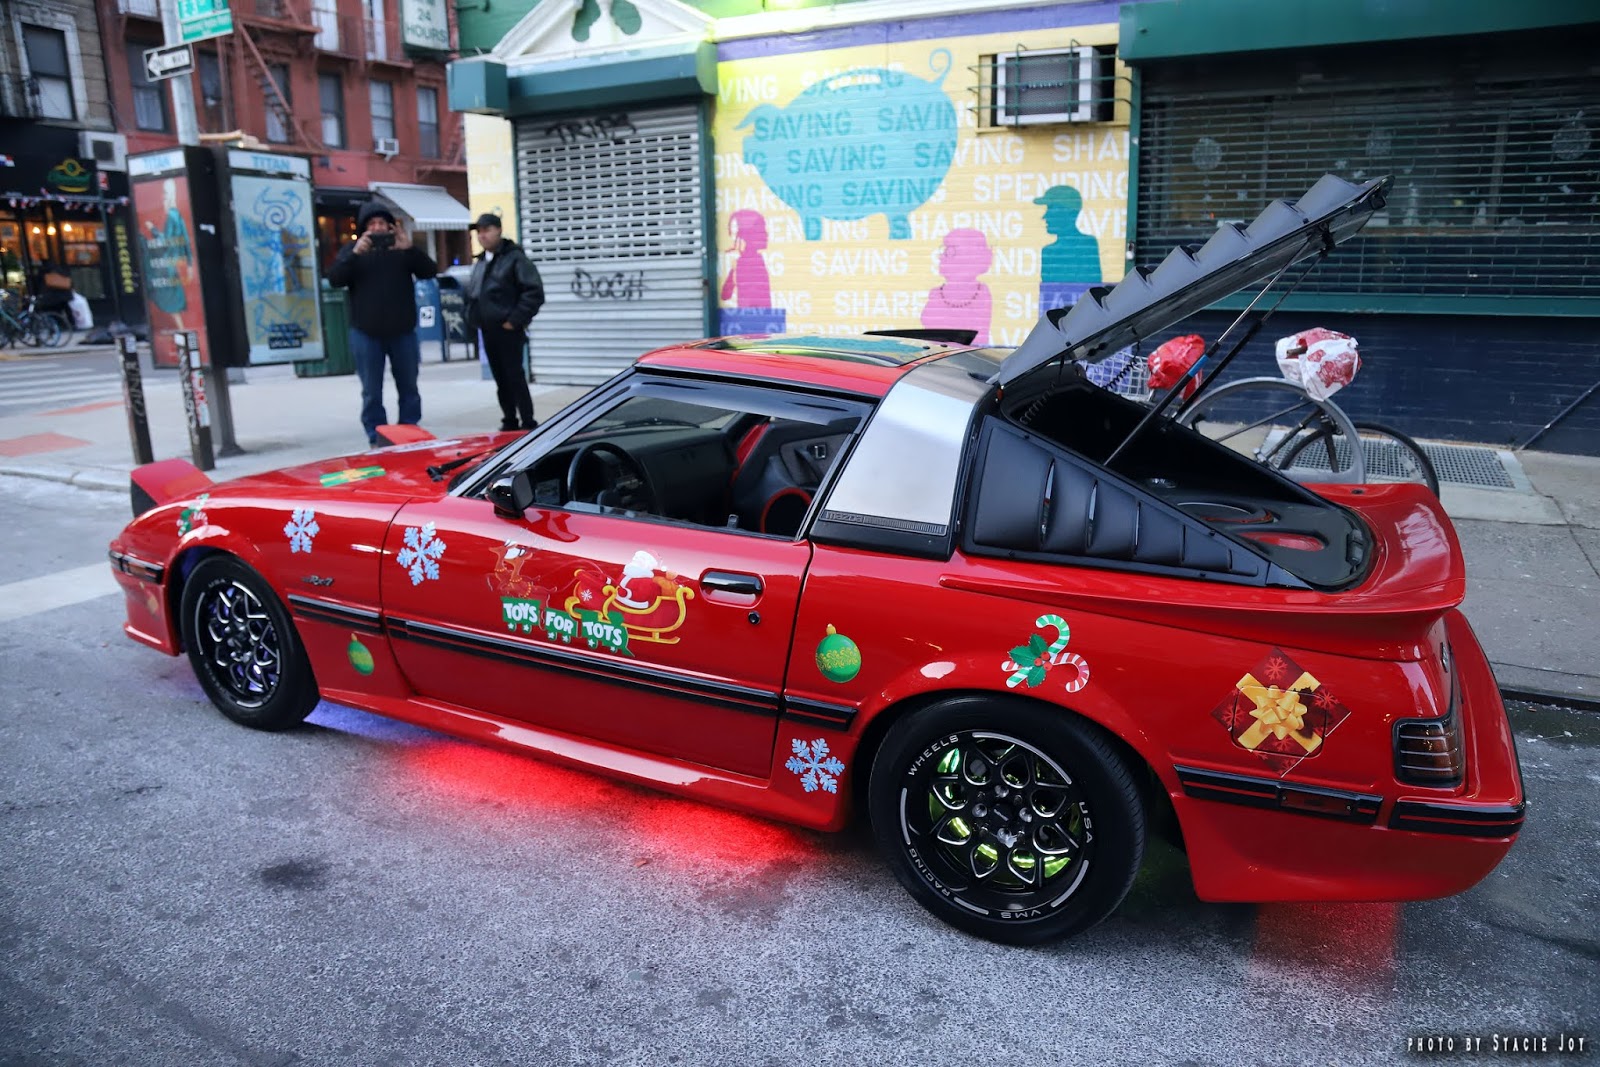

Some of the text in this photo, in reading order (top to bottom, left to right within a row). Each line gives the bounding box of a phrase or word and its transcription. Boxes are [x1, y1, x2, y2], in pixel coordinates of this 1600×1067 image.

[406, 24, 448, 43] HOURS
[755, 111, 851, 141] SAVING
[142, 156, 172, 170] TITAN
[251, 155, 290, 171] TITAN
[786, 144, 886, 173] SAVING
[913, 136, 1025, 170] SAVING
[841, 177, 947, 206] SAVING
[811, 249, 909, 277] SAVING
[503, 602, 622, 646] TOYS FOR TOTS
[907, 734, 960, 777] WHEELS
[1078, 800, 1094, 844] USA
[908, 847, 951, 898] RACING
